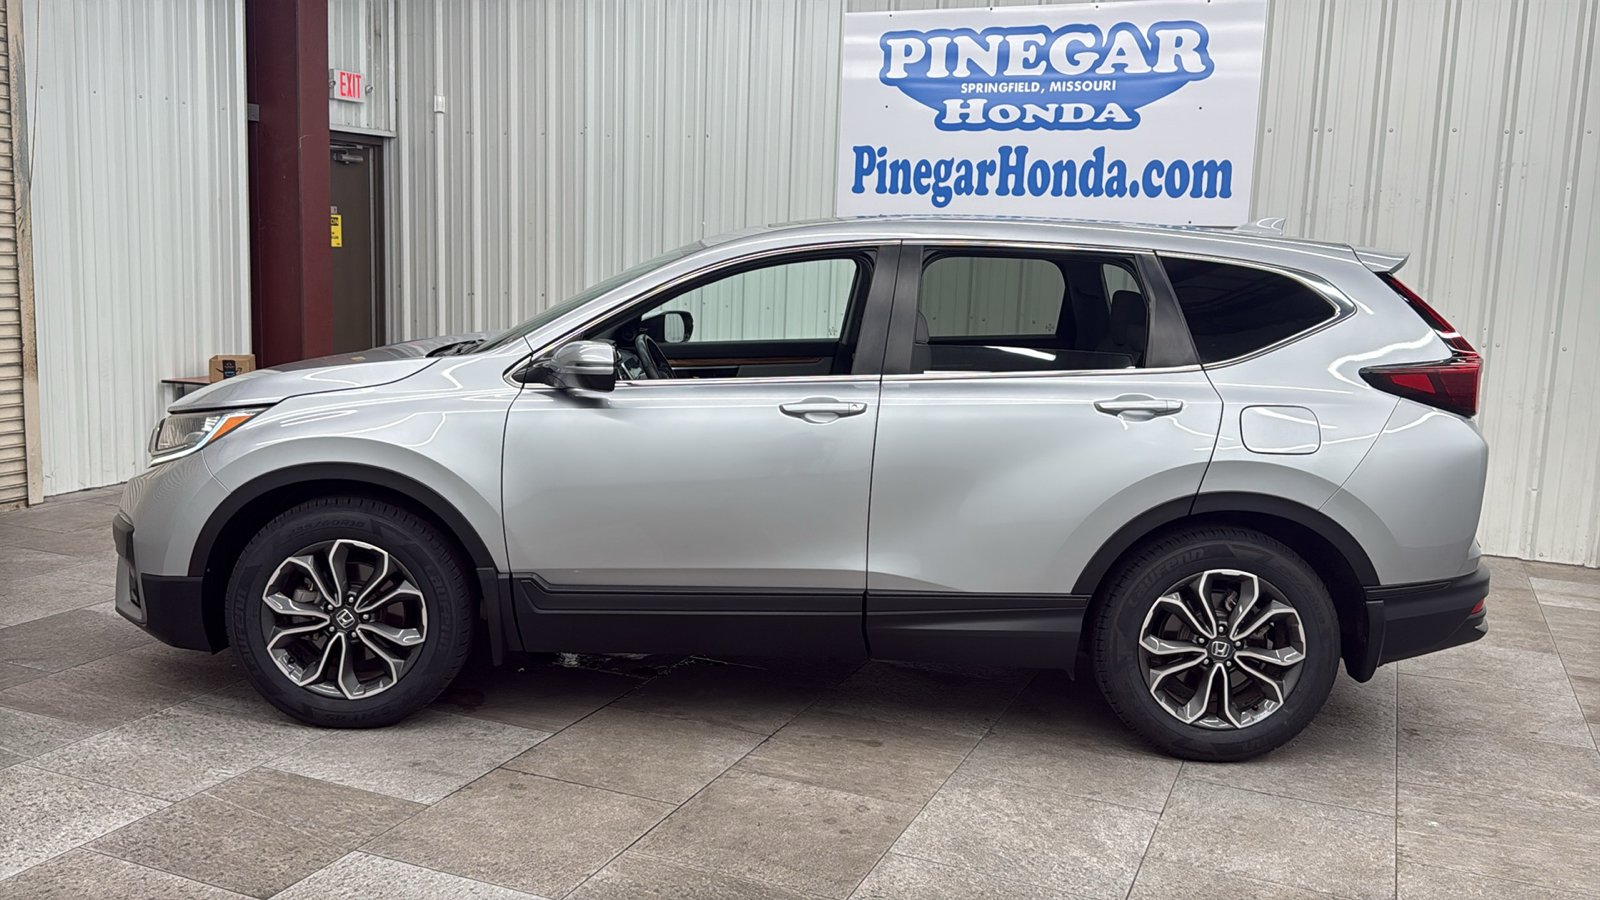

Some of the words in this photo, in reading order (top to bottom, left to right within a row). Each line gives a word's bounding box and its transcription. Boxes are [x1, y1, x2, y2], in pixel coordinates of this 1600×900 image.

[886, 28, 1207, 79] PINEGAR
[339, 71, 362, 99] EXIT
[960, 81, 1045, 94] SPRINGFIELD,
[1049, 80, 1117, 93] MISSOURI
[942, 99, 1133, 124] HONDA
[851, 145, 1233, 208] PinegarHonda.com
